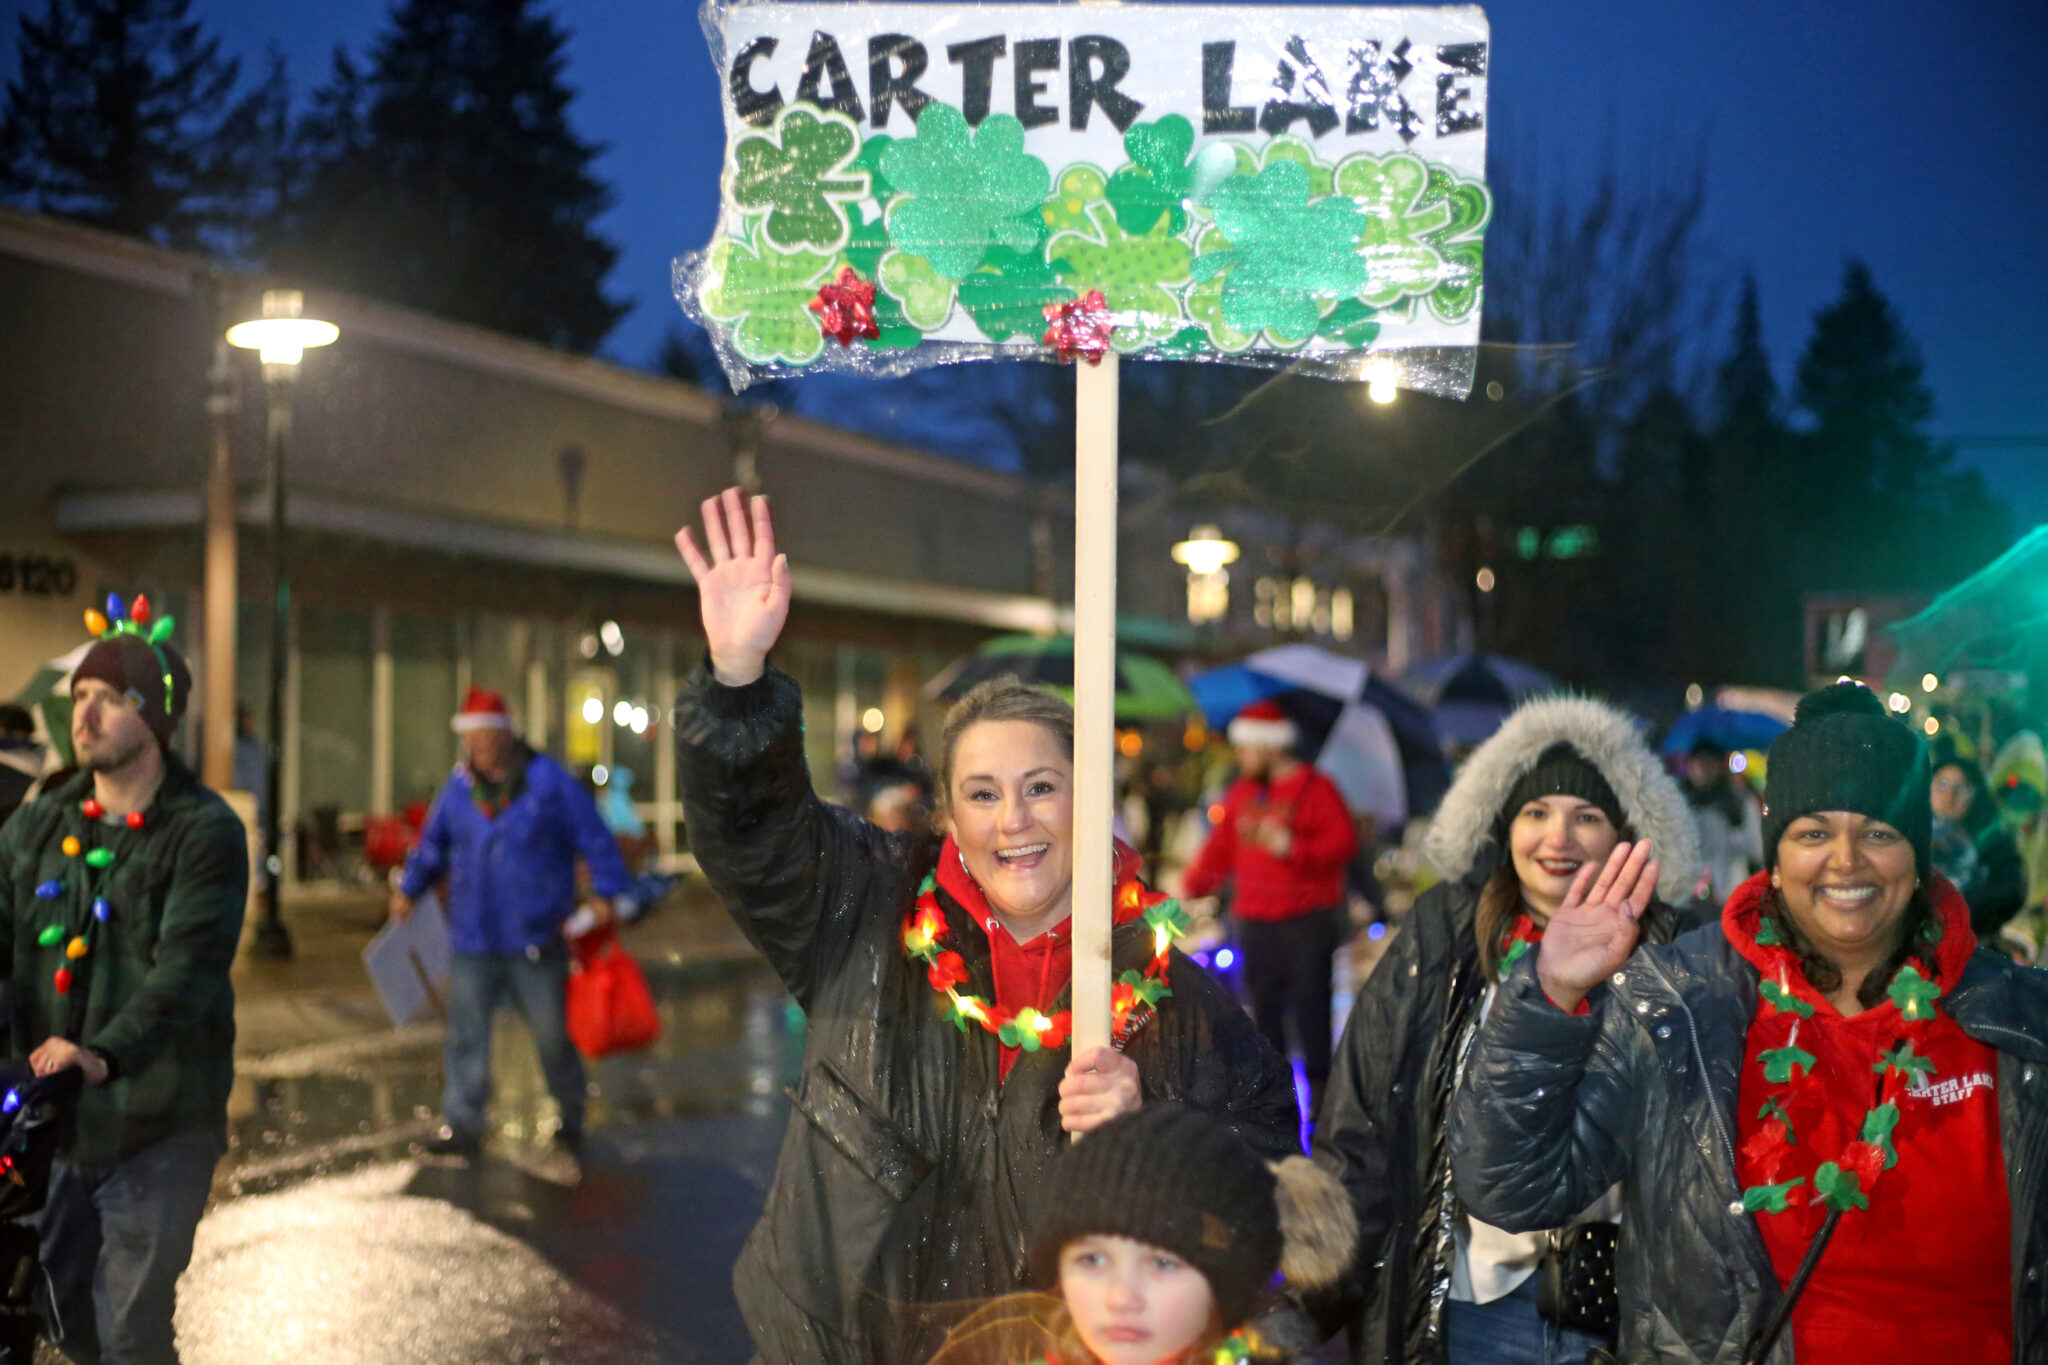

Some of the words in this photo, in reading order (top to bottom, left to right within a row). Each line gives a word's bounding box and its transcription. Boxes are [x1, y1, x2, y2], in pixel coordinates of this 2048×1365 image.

[729, 29, 1145, 134] CARTER
[1202, 34, 1487, 144] LAKE
[1932, 1087, 1974, 1106] STAFF
